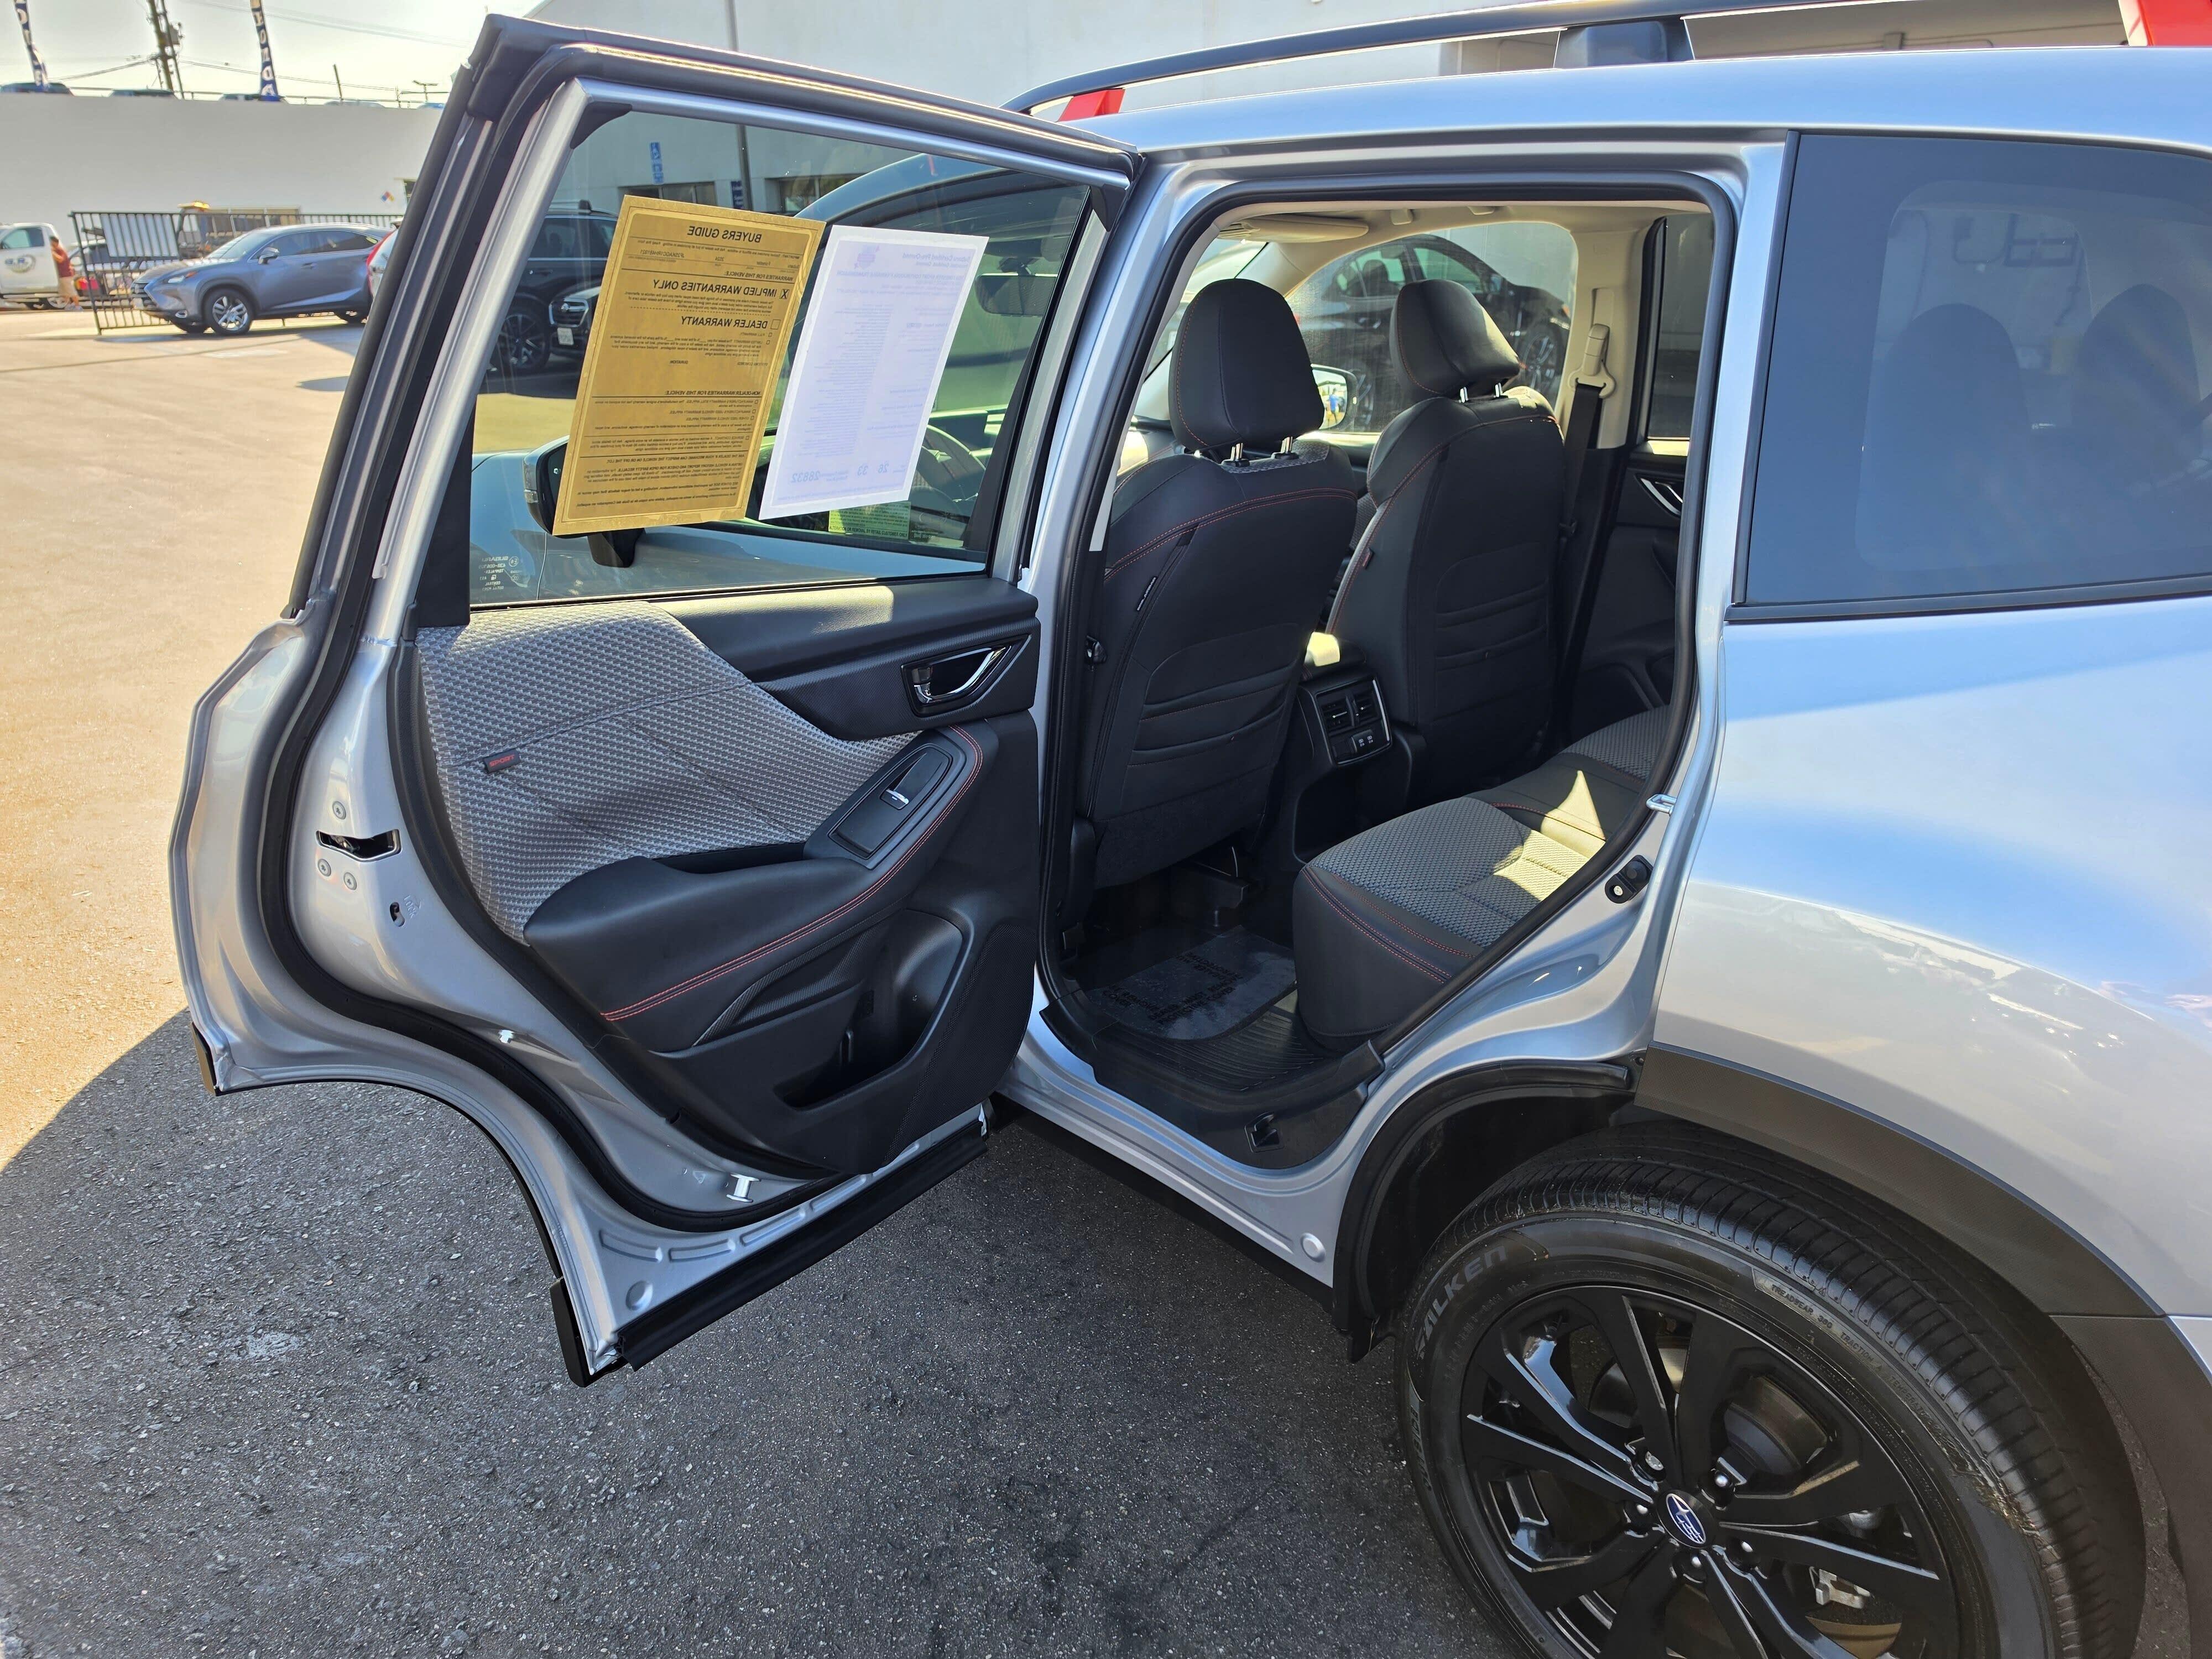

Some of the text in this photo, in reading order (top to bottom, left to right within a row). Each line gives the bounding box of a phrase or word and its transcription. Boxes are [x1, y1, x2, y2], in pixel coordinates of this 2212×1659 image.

[489, 754, 515, 767] SPORT
[404, 895, 416, 919] LOCK
[1415, 1245, 1507, 1360] FALKEN
[1771, 1284, 1814, 1316] TREADWEAR
[1840, 1331, 1875, 1362] TRACTION
